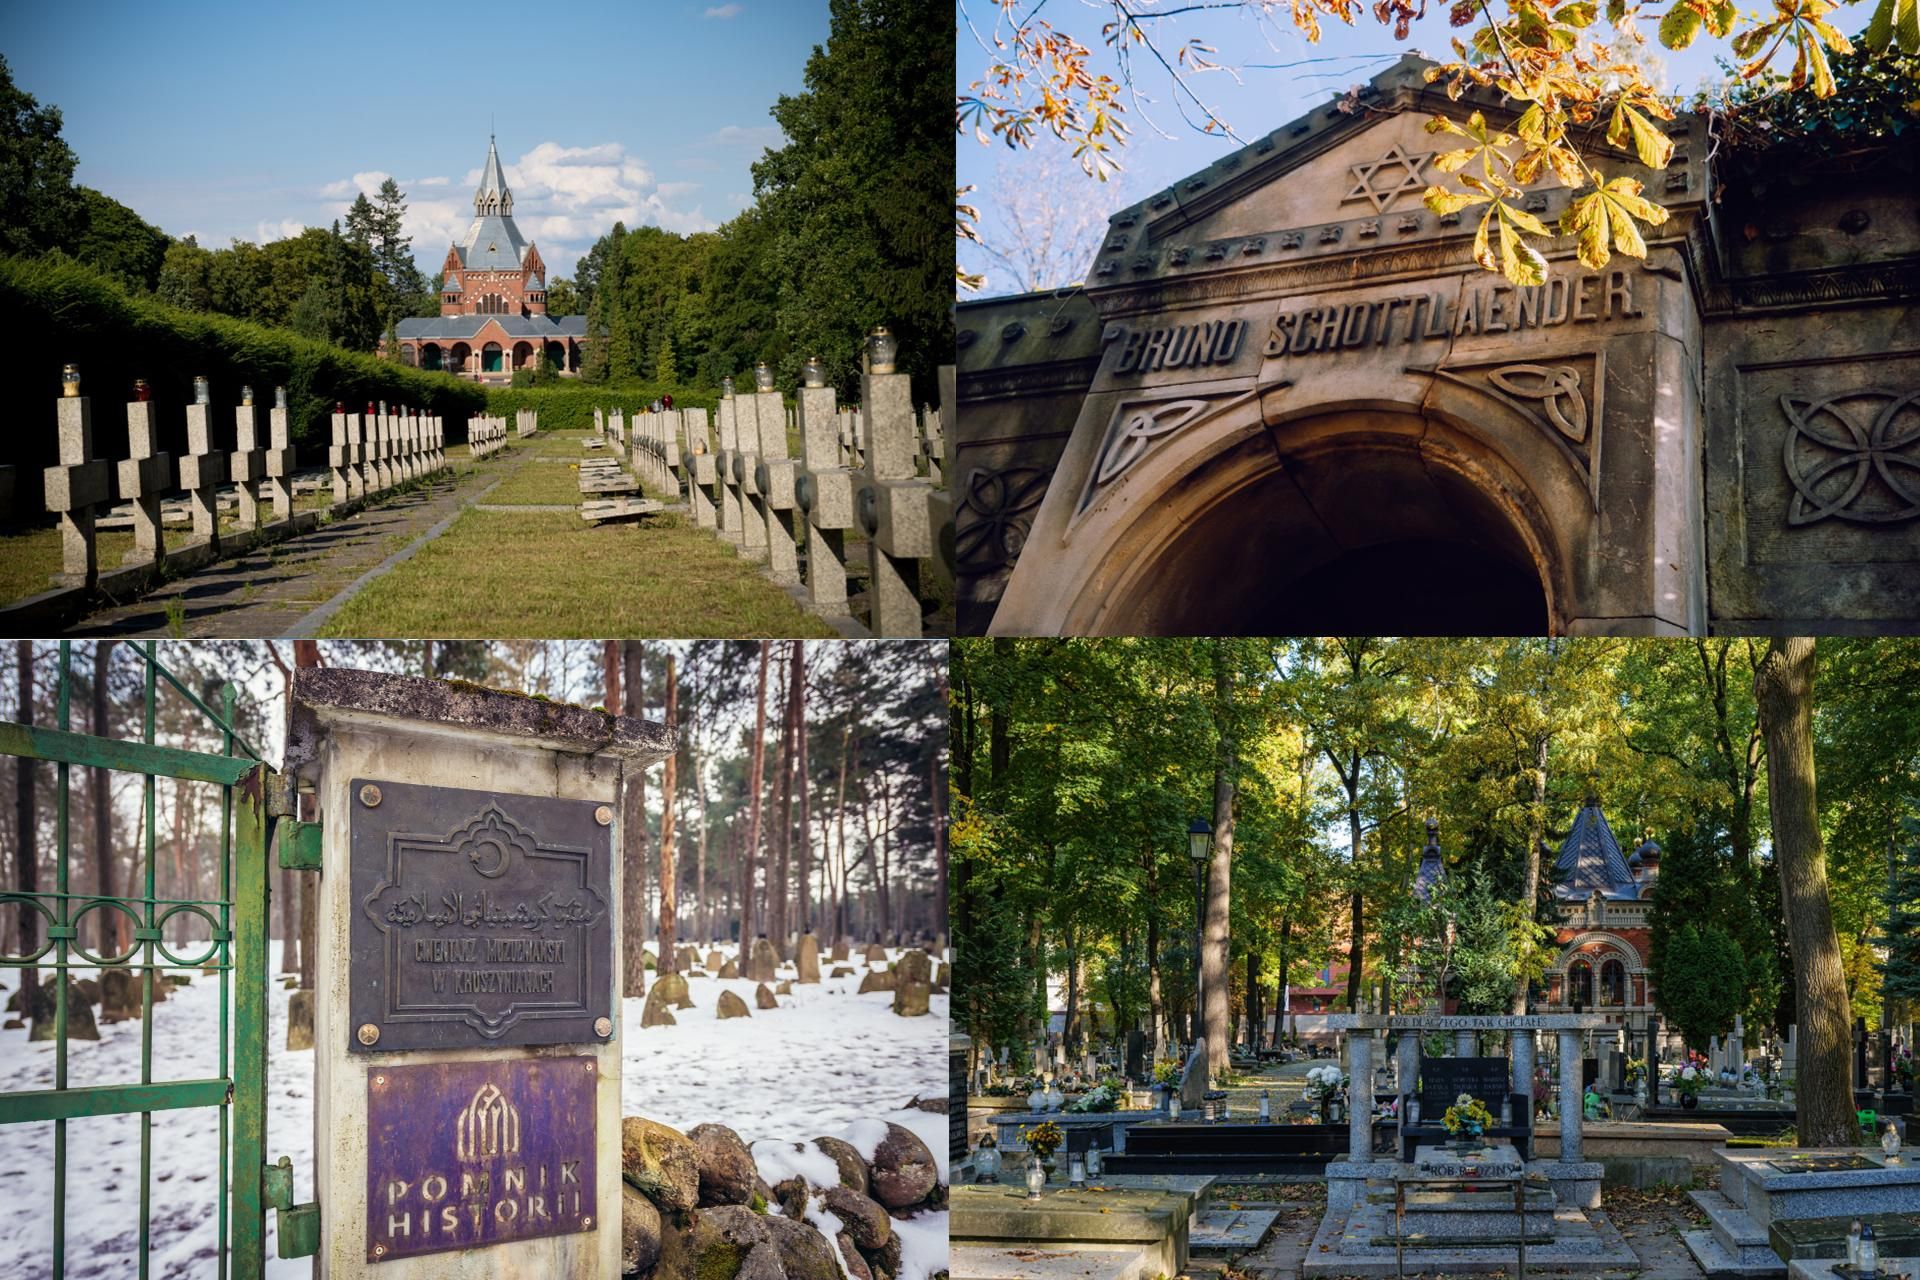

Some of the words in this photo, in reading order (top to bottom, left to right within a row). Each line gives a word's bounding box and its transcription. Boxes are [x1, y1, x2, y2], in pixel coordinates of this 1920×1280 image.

[1114, 317, 1249, 376] BRUNO
[415, 938, 476, 963] CMENTARZ
[432, 969, 446, 993] W
[1473, 1017, 1494, 1028] TAK
[387, 1160, 580, 1207] POMNIK
[387, 1191, 582, 1238] HISTORII
